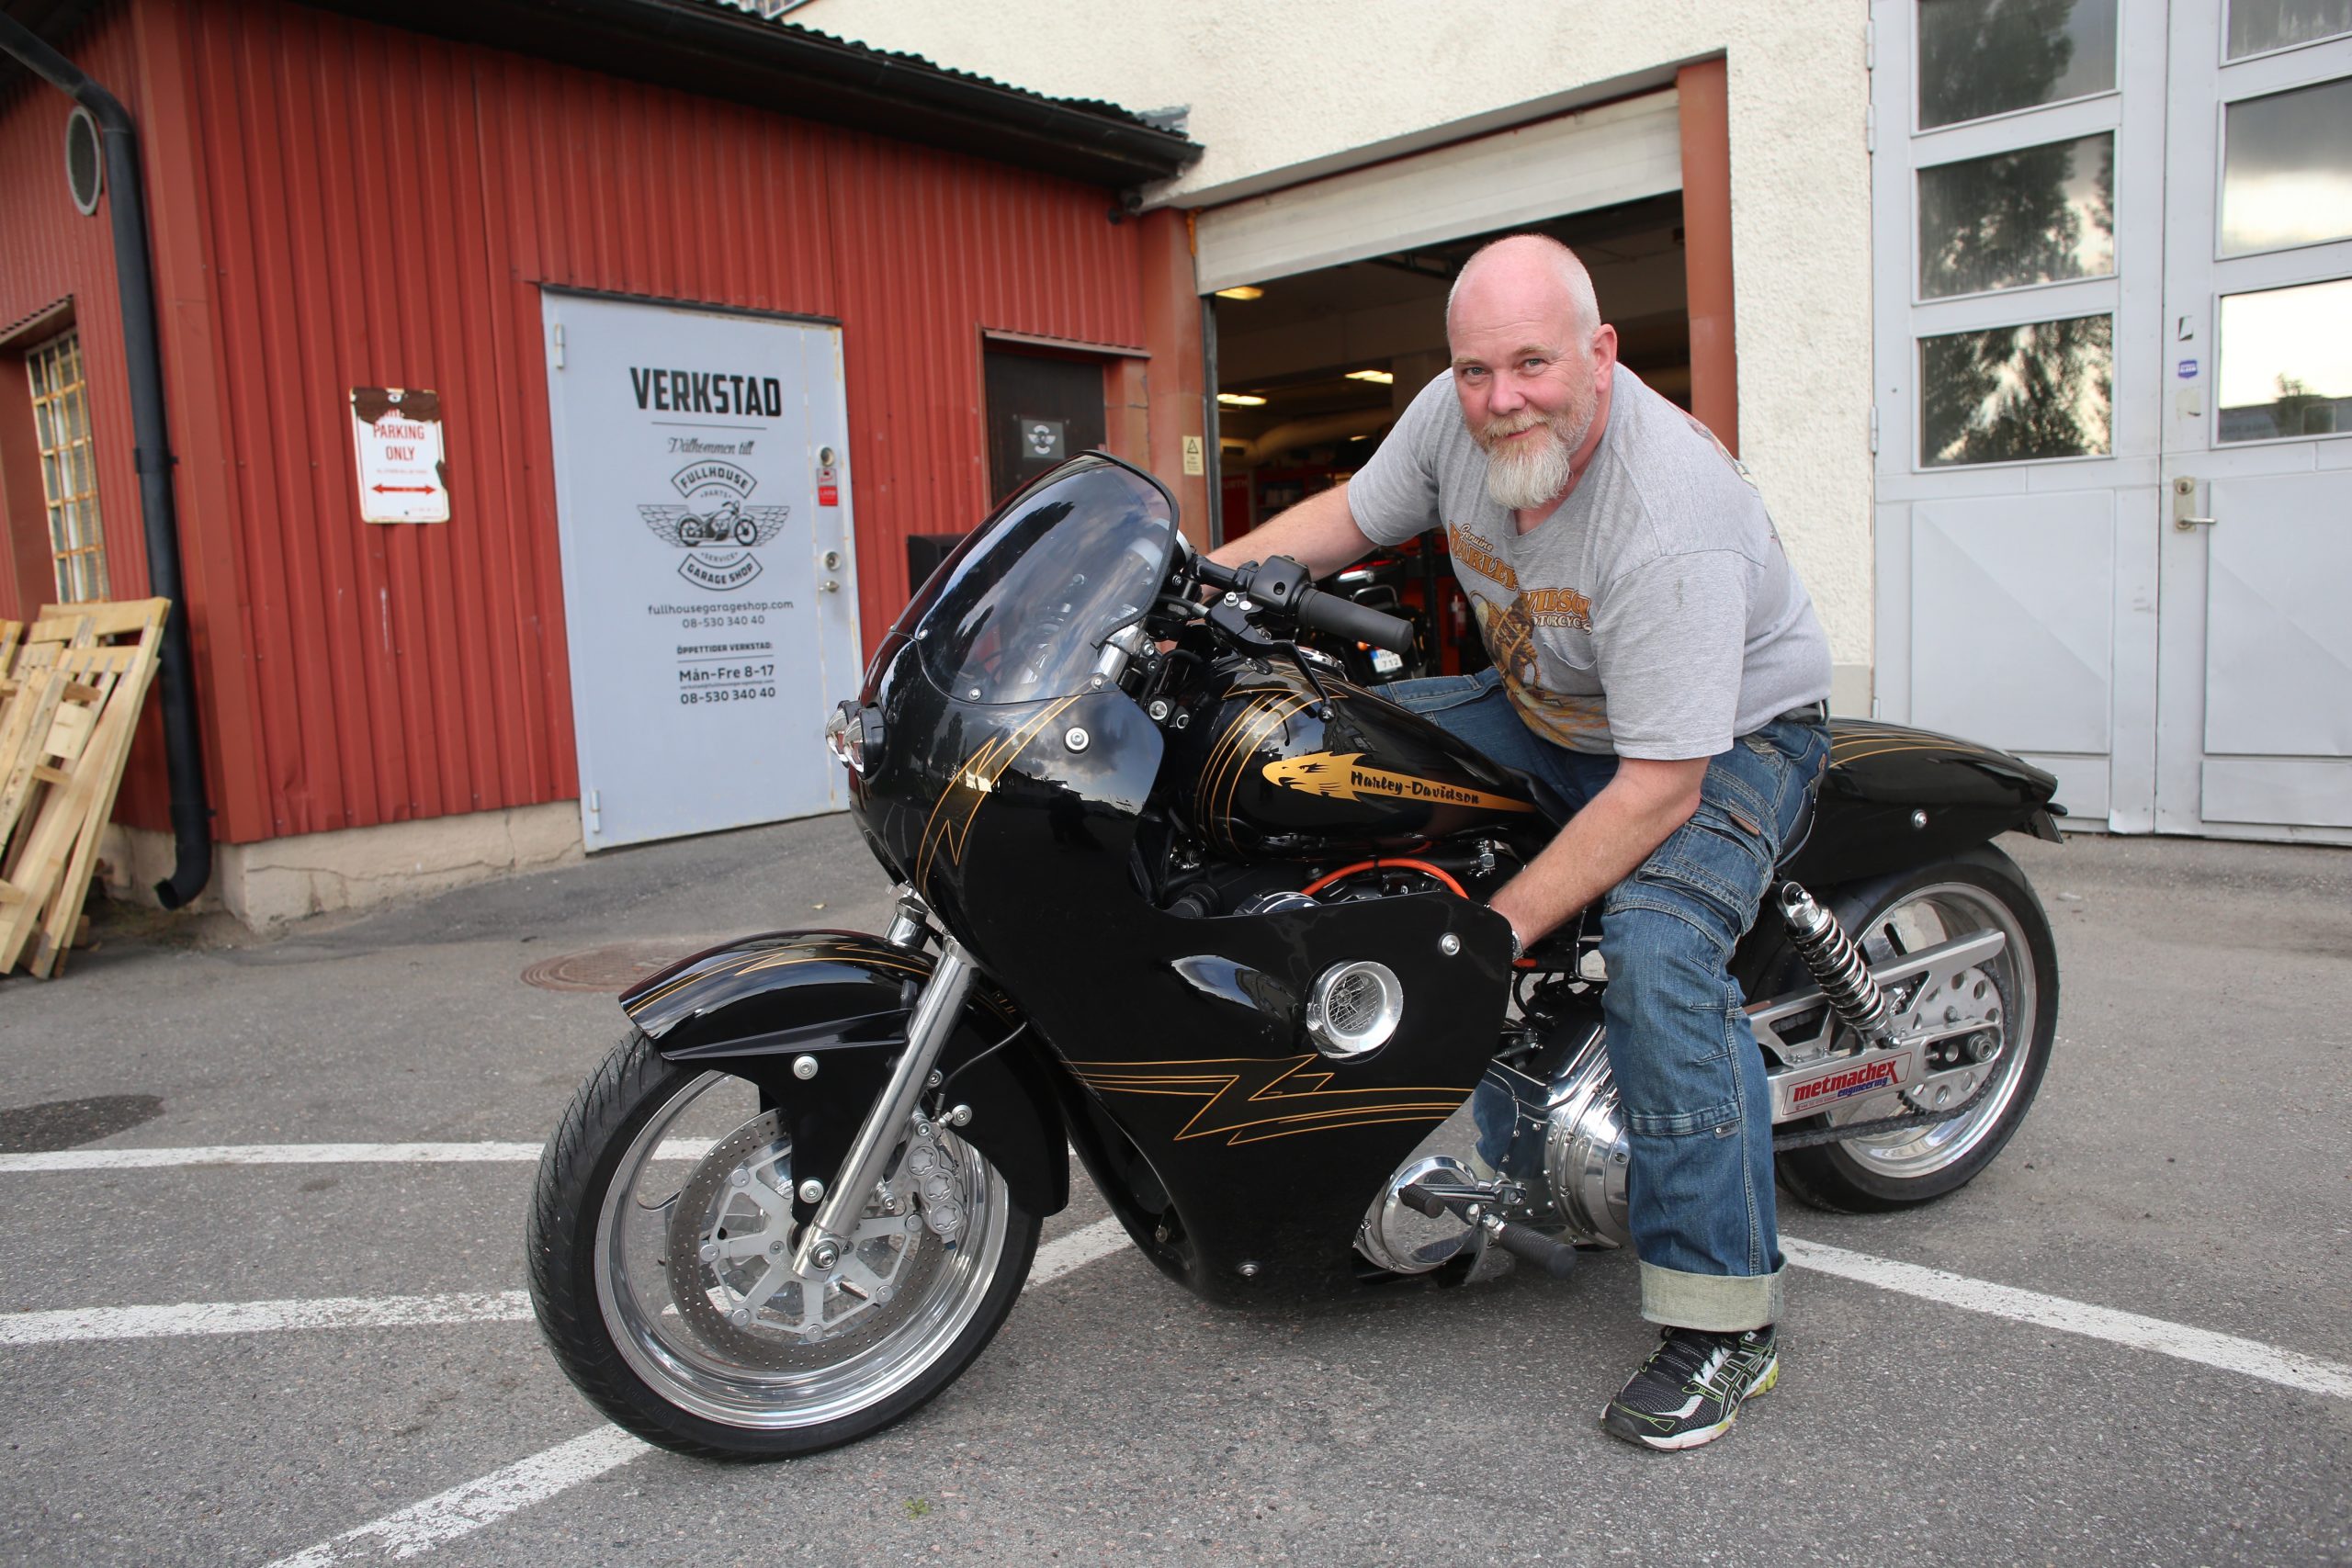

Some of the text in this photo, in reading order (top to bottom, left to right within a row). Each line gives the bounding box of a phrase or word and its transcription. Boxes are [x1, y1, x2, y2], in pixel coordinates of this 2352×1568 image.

[630, 367, 783, 417] VERKSTAD
[373, 423, 424, 439] PARKING
[386, 446, 414, 460] ONLY
[680, 467, 749, 490] FULLHOUSE
[1461, 524, 1494, 552] Genuine
[687, 562, 753, 584] GARAGE SHOP
[648, 600, 794, 615] fullhousegarageshop.com
[682, 615, 765, 628] 08-530 340 40
[679, 664, 775, 682] Mån-Fre 8-17
[681, 687, 775, 705] 08-530 340 40
[1350, 770, 1480, 805] Harley-Davidson
[1792, 1061, 1898, 1102] metmachex
[1837, 1077, 1888, 1098] engineering
